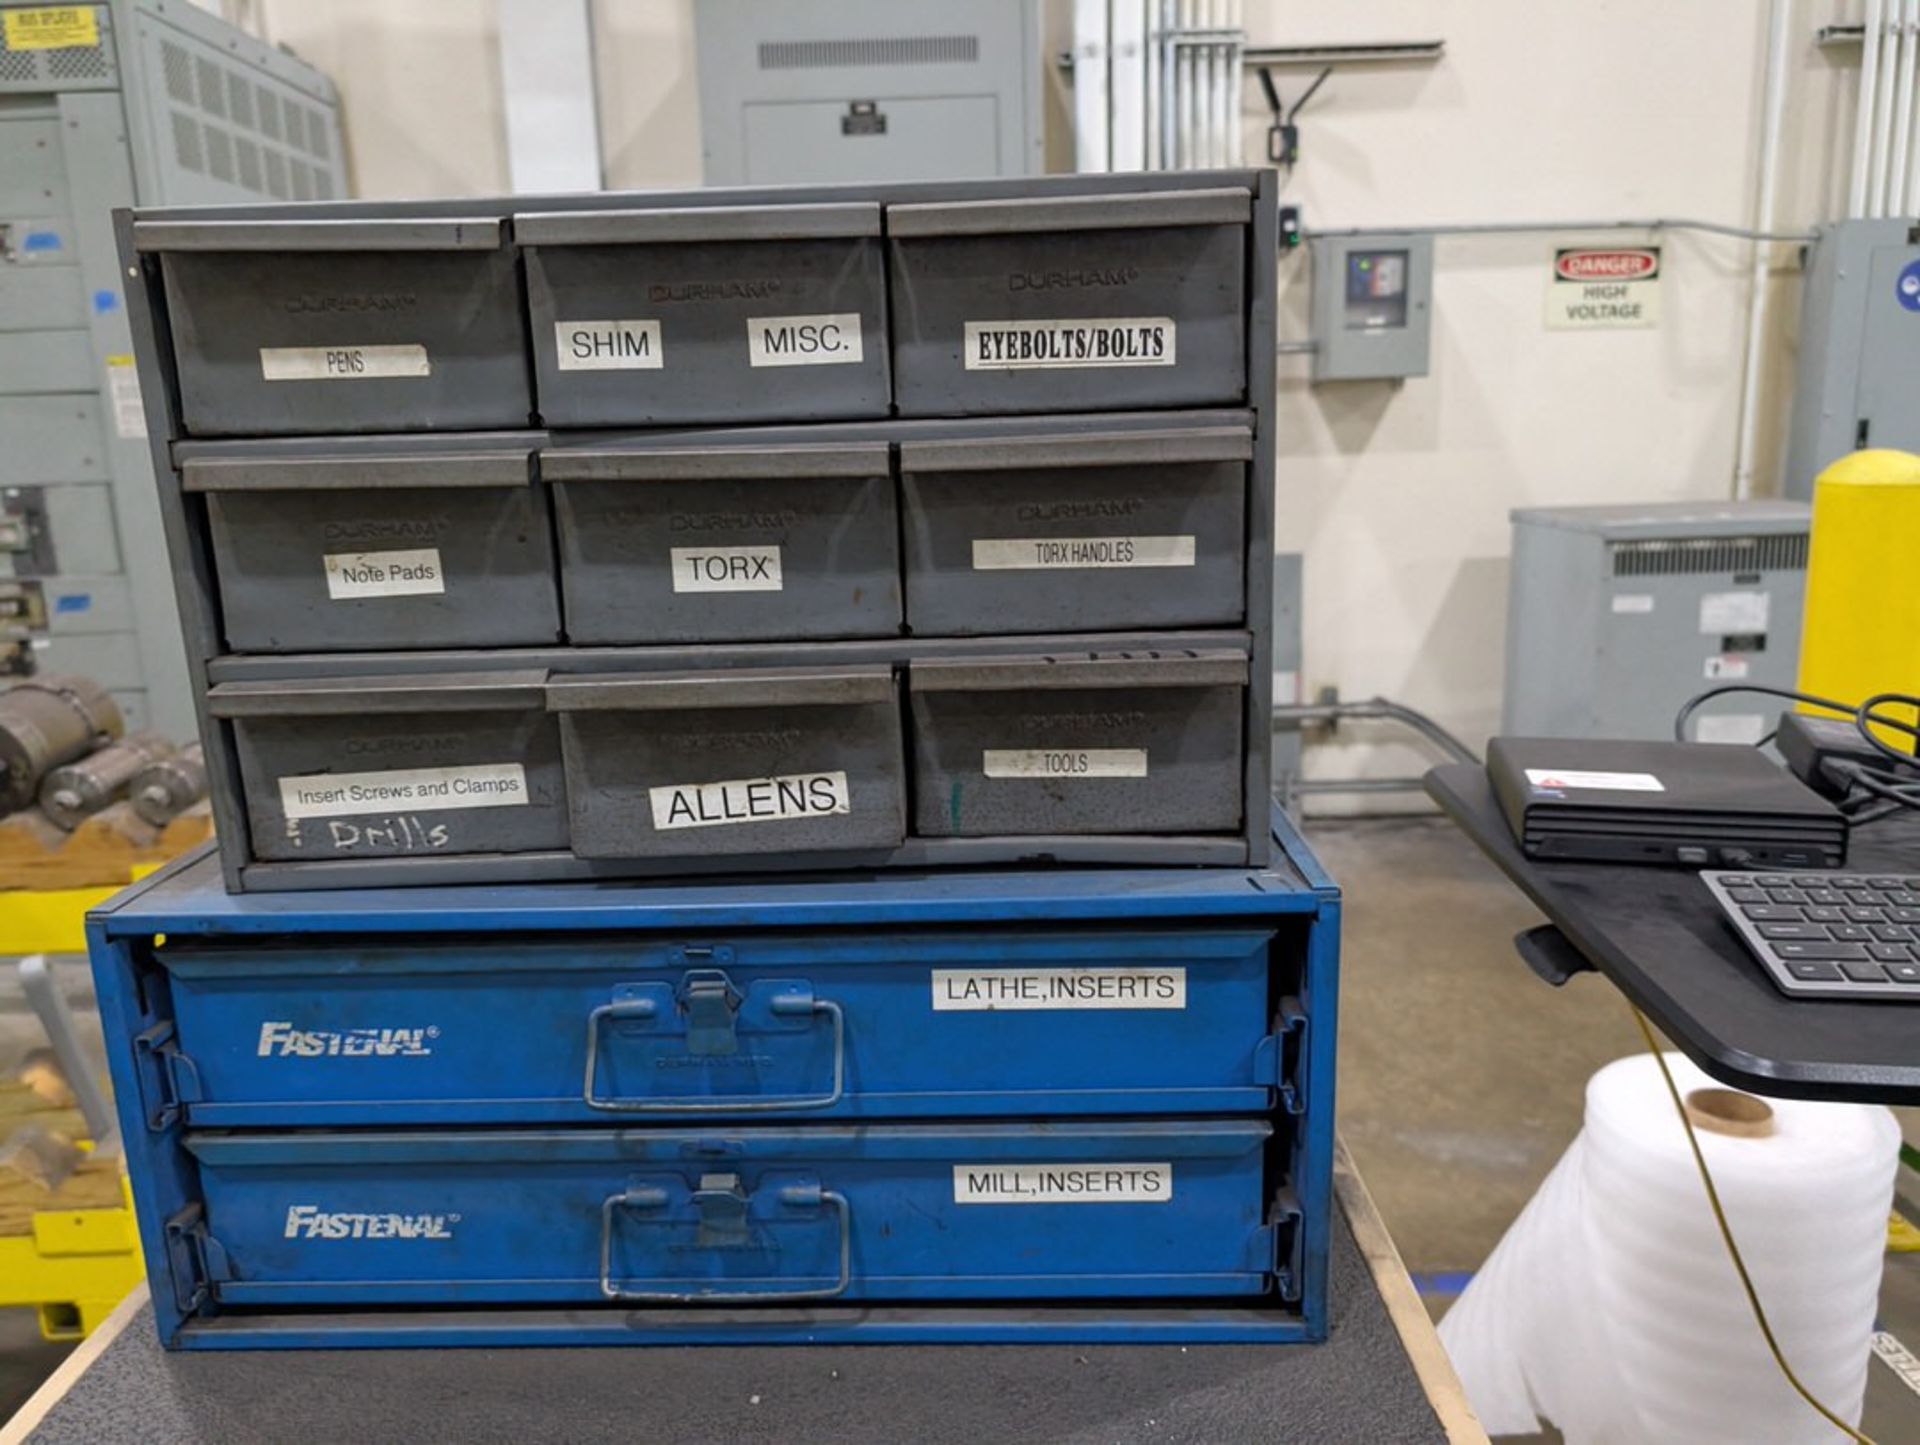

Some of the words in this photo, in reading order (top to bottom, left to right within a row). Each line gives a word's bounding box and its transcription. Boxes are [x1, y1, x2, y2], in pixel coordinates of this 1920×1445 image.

[1569, 255, 1642, 275] DANGER
[1583, 285, 1628, 299] HIGH
[1566, 303, 1643, 320] VOLTAGE
[572, 330, 650, 358] SHIM
[763, 325, 849, 354] MISC.
[978, 327, 1164, 360] EYEBOLTS/BOLTS
[326, 350, 365, 373] PENS
[1034, 543, 1068, 563] TORX
[1071, 541, 1134, 563] HANDLES
[342, 564, 385, 583] Note
[389, 563, 436, 581] Pads
[685, 556, 770, 581] TORX
[1044, 753, 1089, 773] TOOLS
[297, 788, 346, 806] Insert
[350, 784, 413, 802] Screws
[417, 779, 450, 797] and
[452, 776, 520, 797] Clamps
[668, 777, 837, 824] ALLENS
[328, 815, 449, 849] Drills
[947, 975, 1175, 1002] LATHE,INSERTS
[968, 1170, 1161, 1196] MILL,INSERTS
